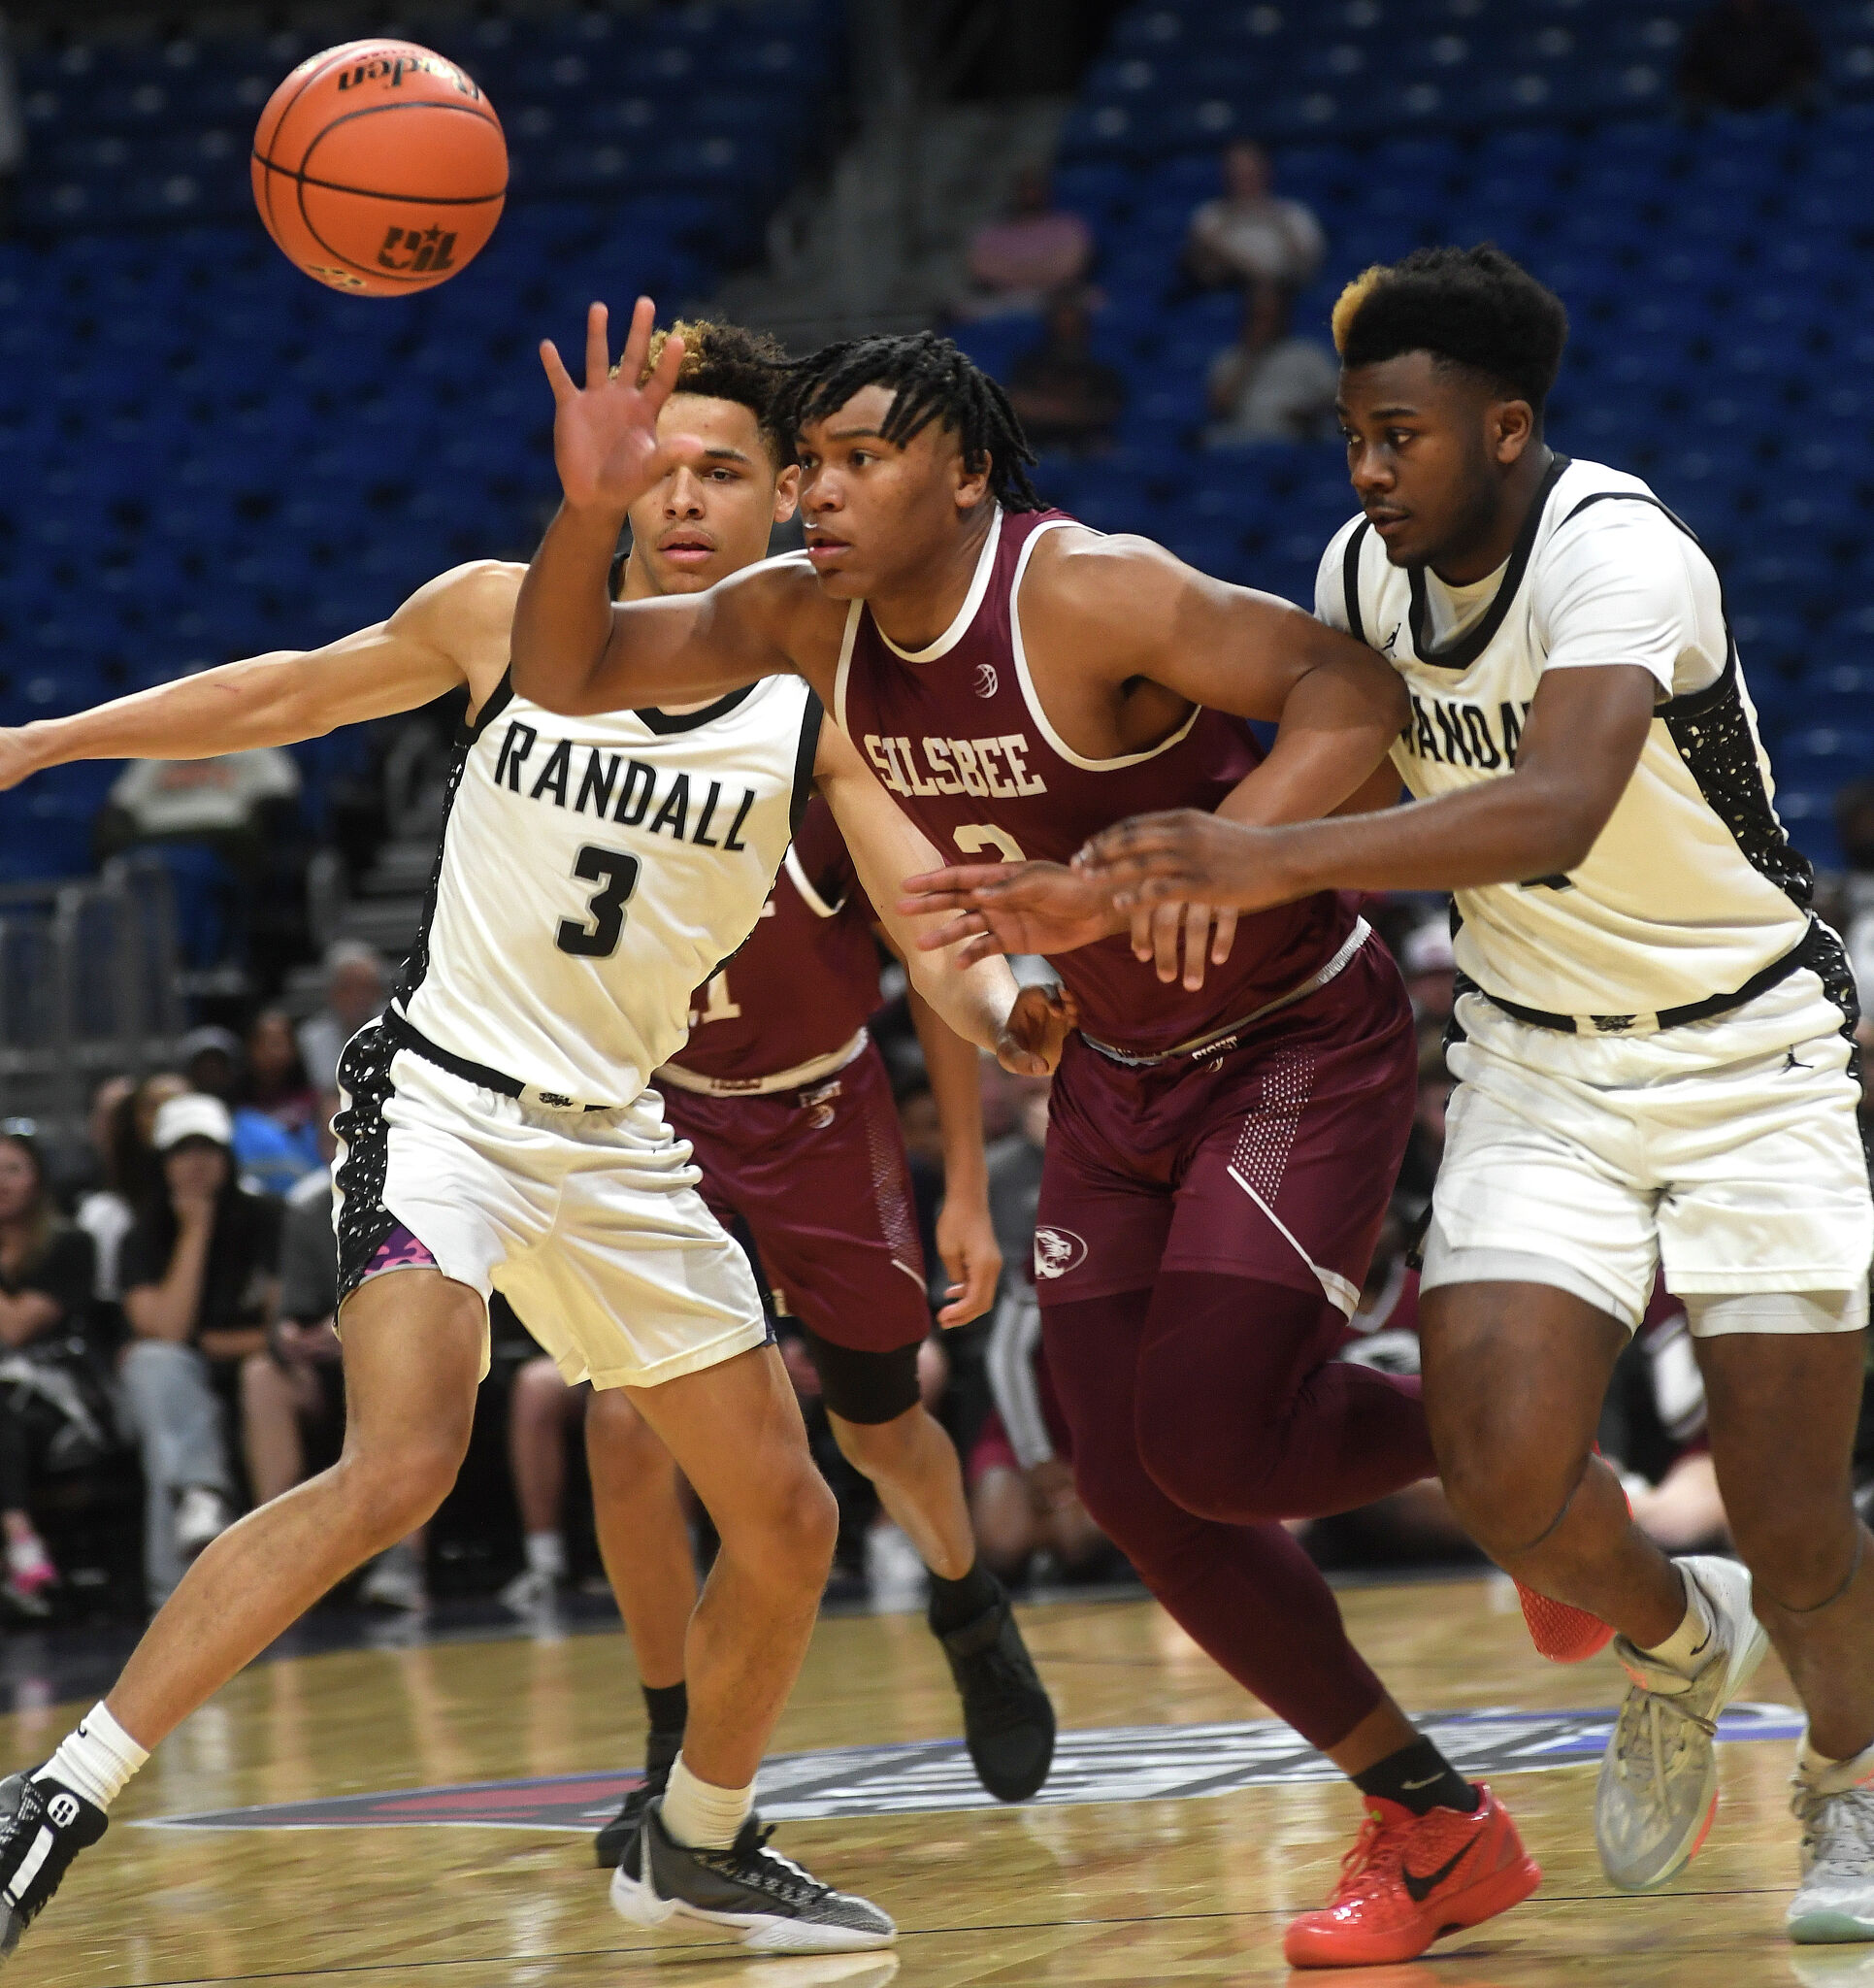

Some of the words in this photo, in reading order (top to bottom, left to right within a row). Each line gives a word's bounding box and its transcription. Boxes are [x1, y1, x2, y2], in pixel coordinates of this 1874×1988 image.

[863, 733, 1048, 799] SILSBEE
[1400, 695, 1531, 769] ANDA
[494, 719, 756, 851] RANDALL
[554, 842, 642, 960] 3
